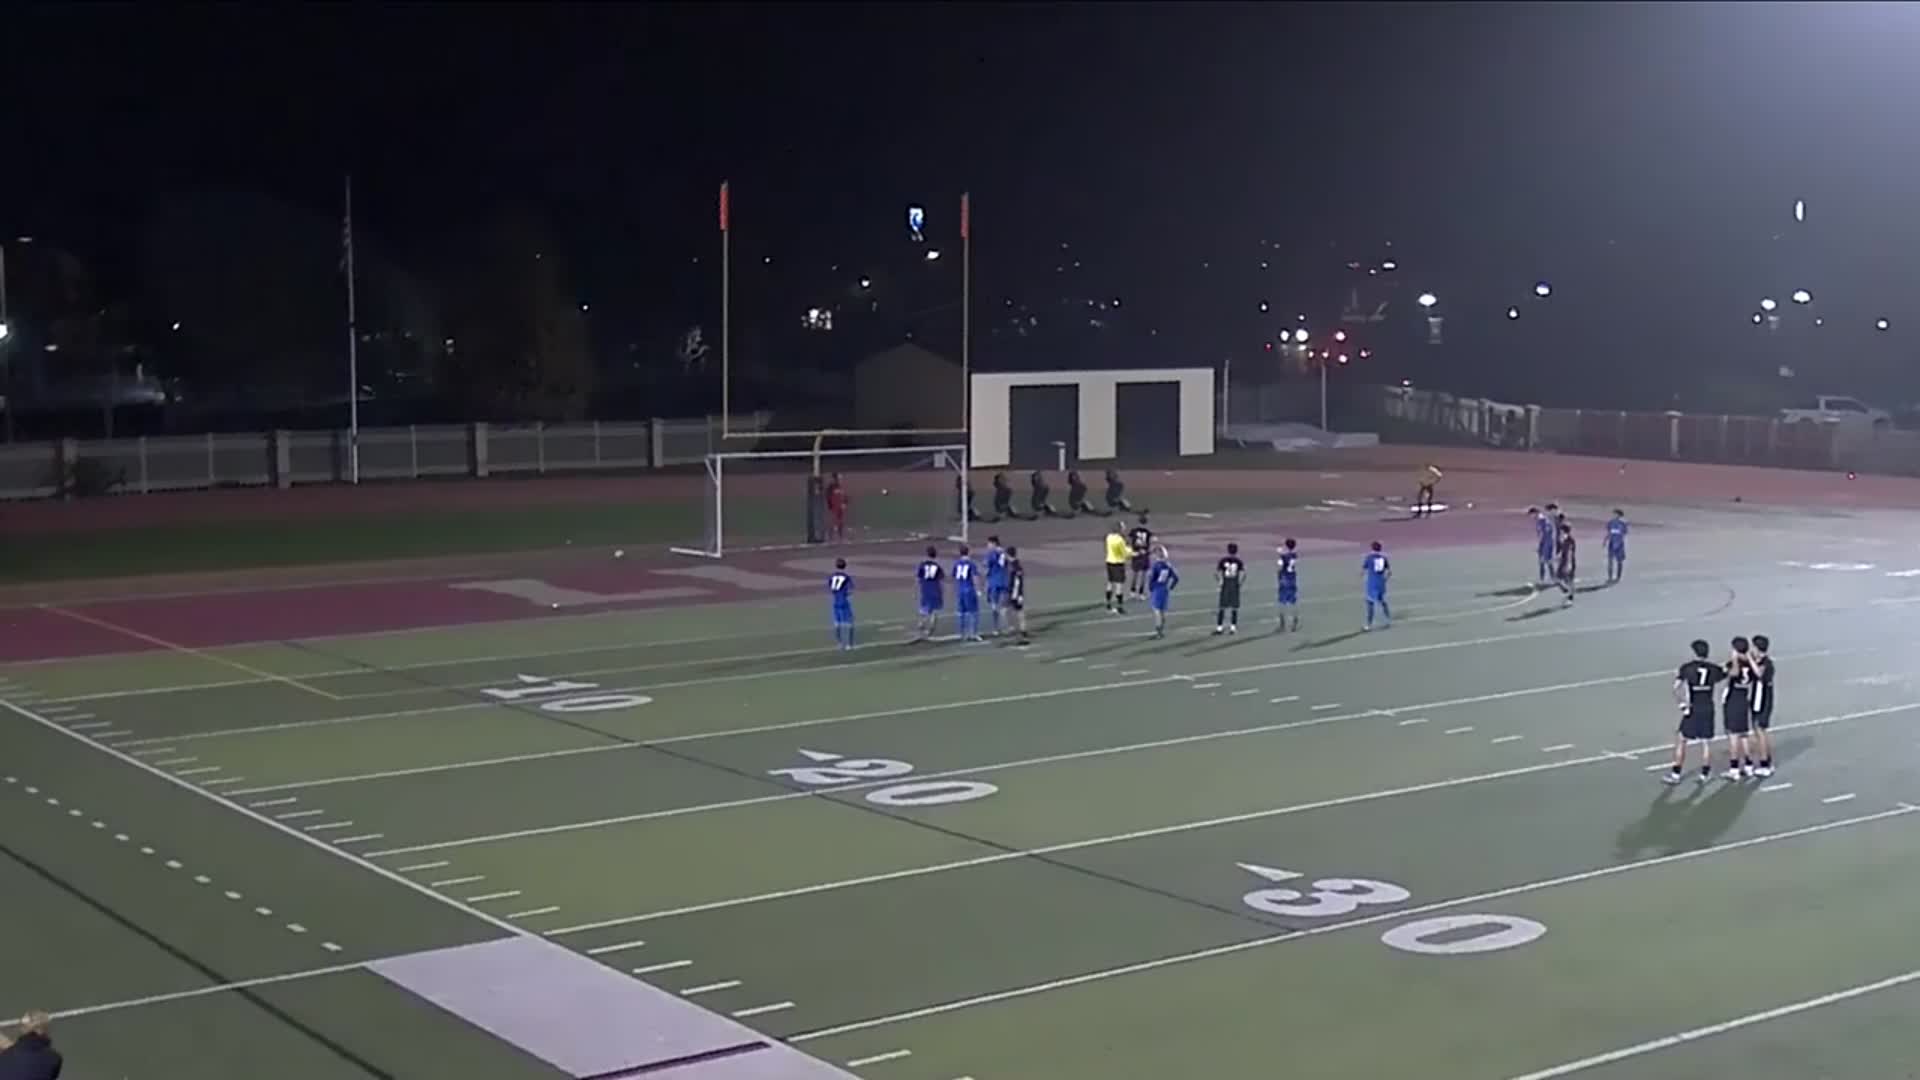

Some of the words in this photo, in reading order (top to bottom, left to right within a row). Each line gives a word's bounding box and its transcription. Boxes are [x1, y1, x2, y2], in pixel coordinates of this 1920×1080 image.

[831, 575, 847, 591] 17
[1697, 667, 1709, 686] 7
[480, 680, 654, 712] 10
[767, 758, 999, 806] 20
[1243, 878, 1547, 953] 30
